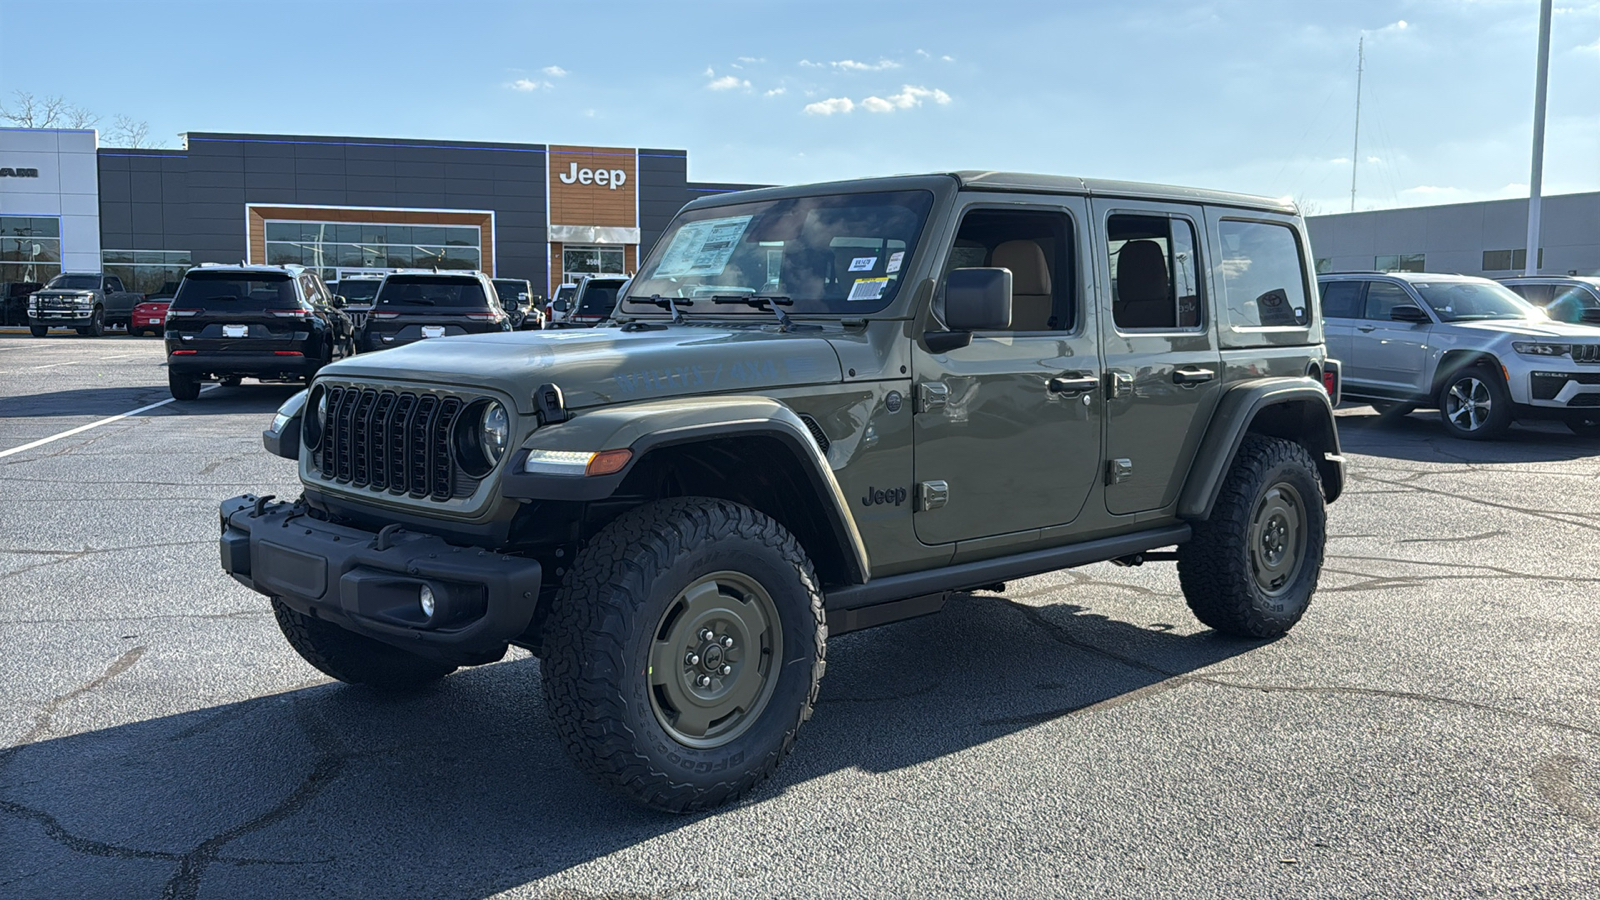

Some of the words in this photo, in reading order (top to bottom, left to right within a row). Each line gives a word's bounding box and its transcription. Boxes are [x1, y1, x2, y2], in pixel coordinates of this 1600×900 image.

[559, 162, 627, 190] Jeep
[614, 366, 703, 393] WILLYS
[861, 486, 907, 507] Jeep
